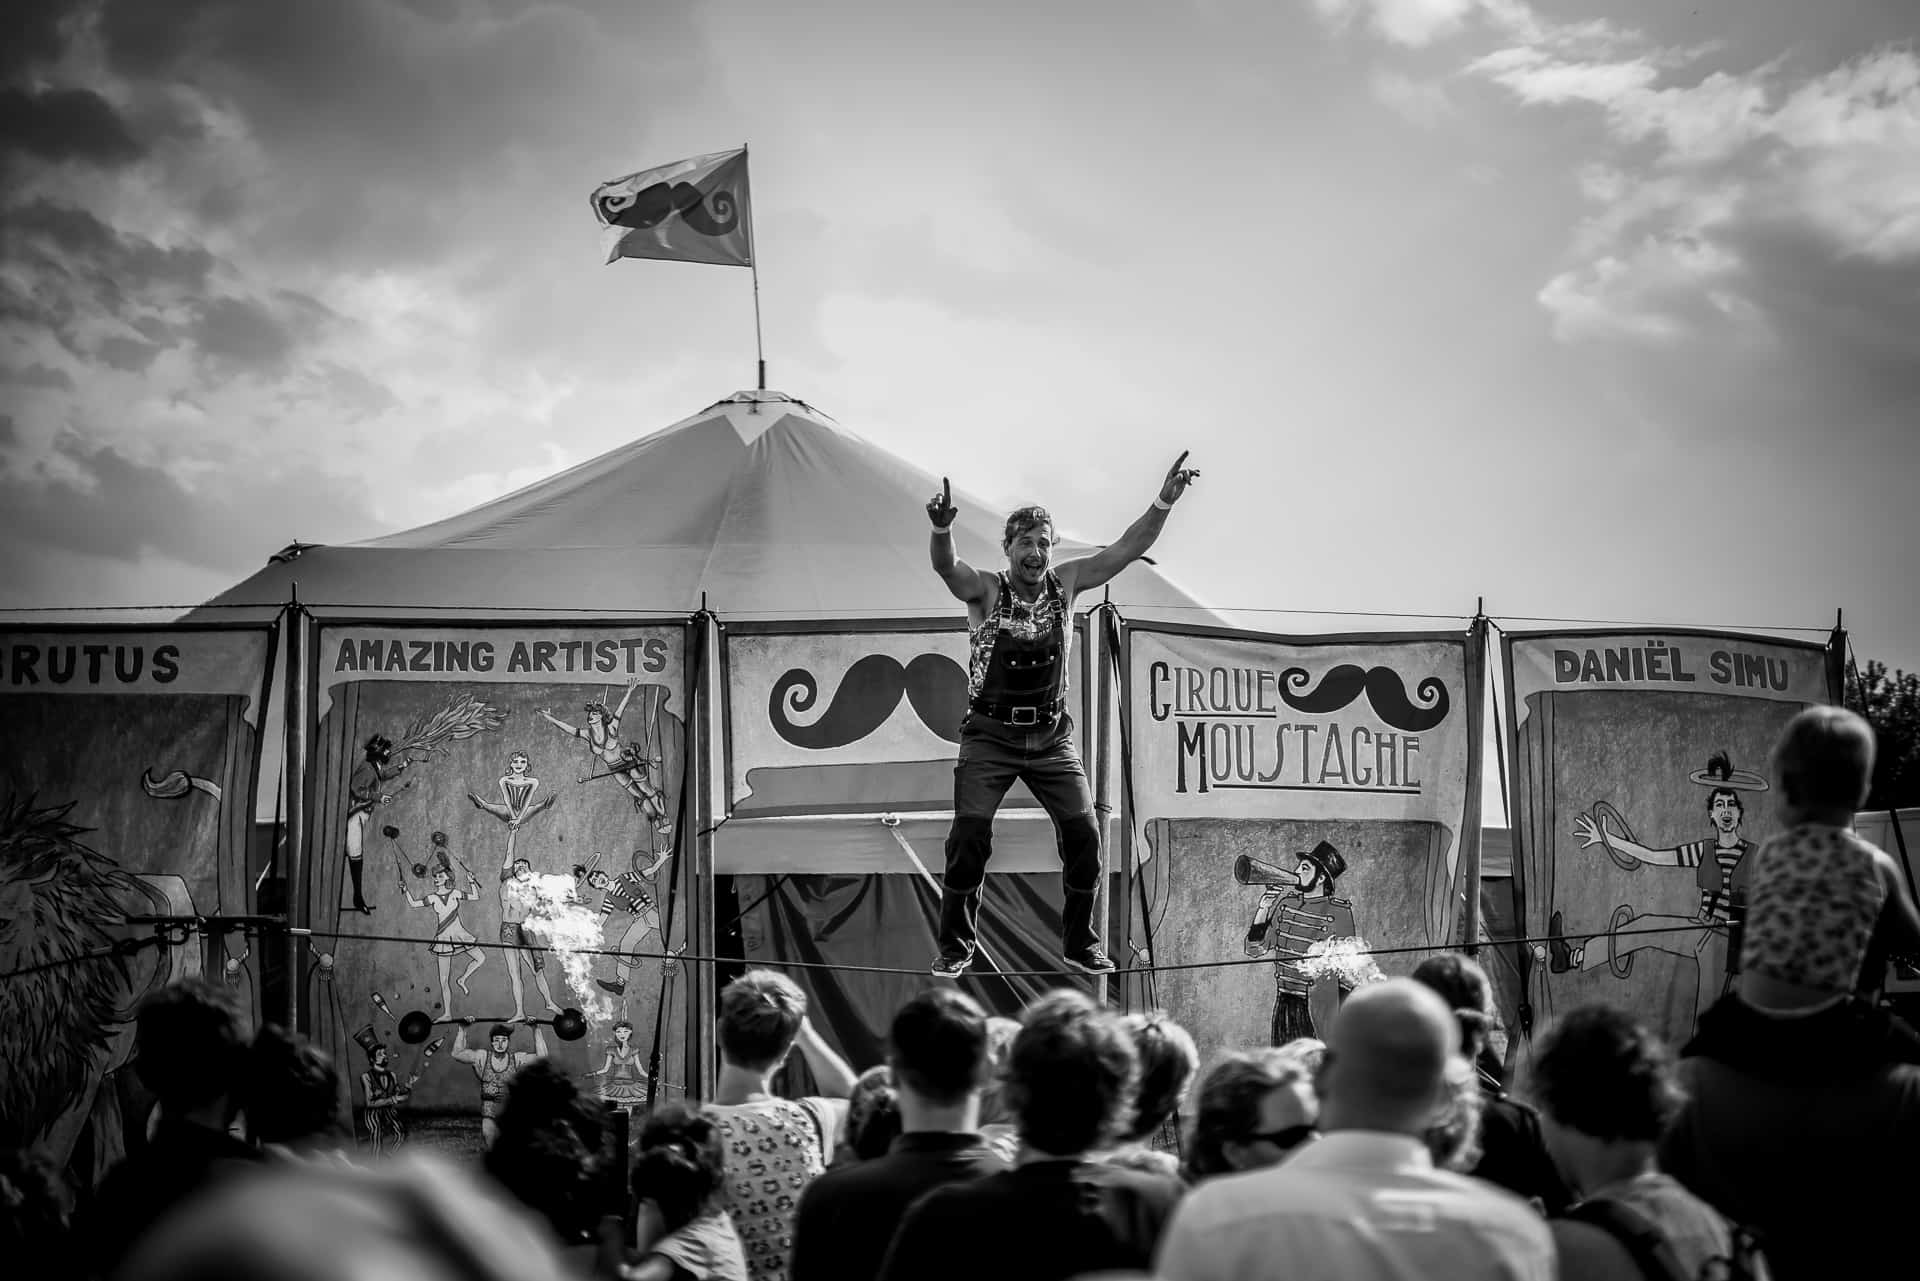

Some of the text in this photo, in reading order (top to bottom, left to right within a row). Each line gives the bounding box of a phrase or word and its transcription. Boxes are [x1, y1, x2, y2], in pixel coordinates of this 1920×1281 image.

[0, 645, 180, 685] RUTUS
[335, 638, 668, 673] AMAZING ARTISTS
[1554, 640, 1789, 690] DANIËL SIMU
[1175, 721, 1421, 793] MOUSTACHE
